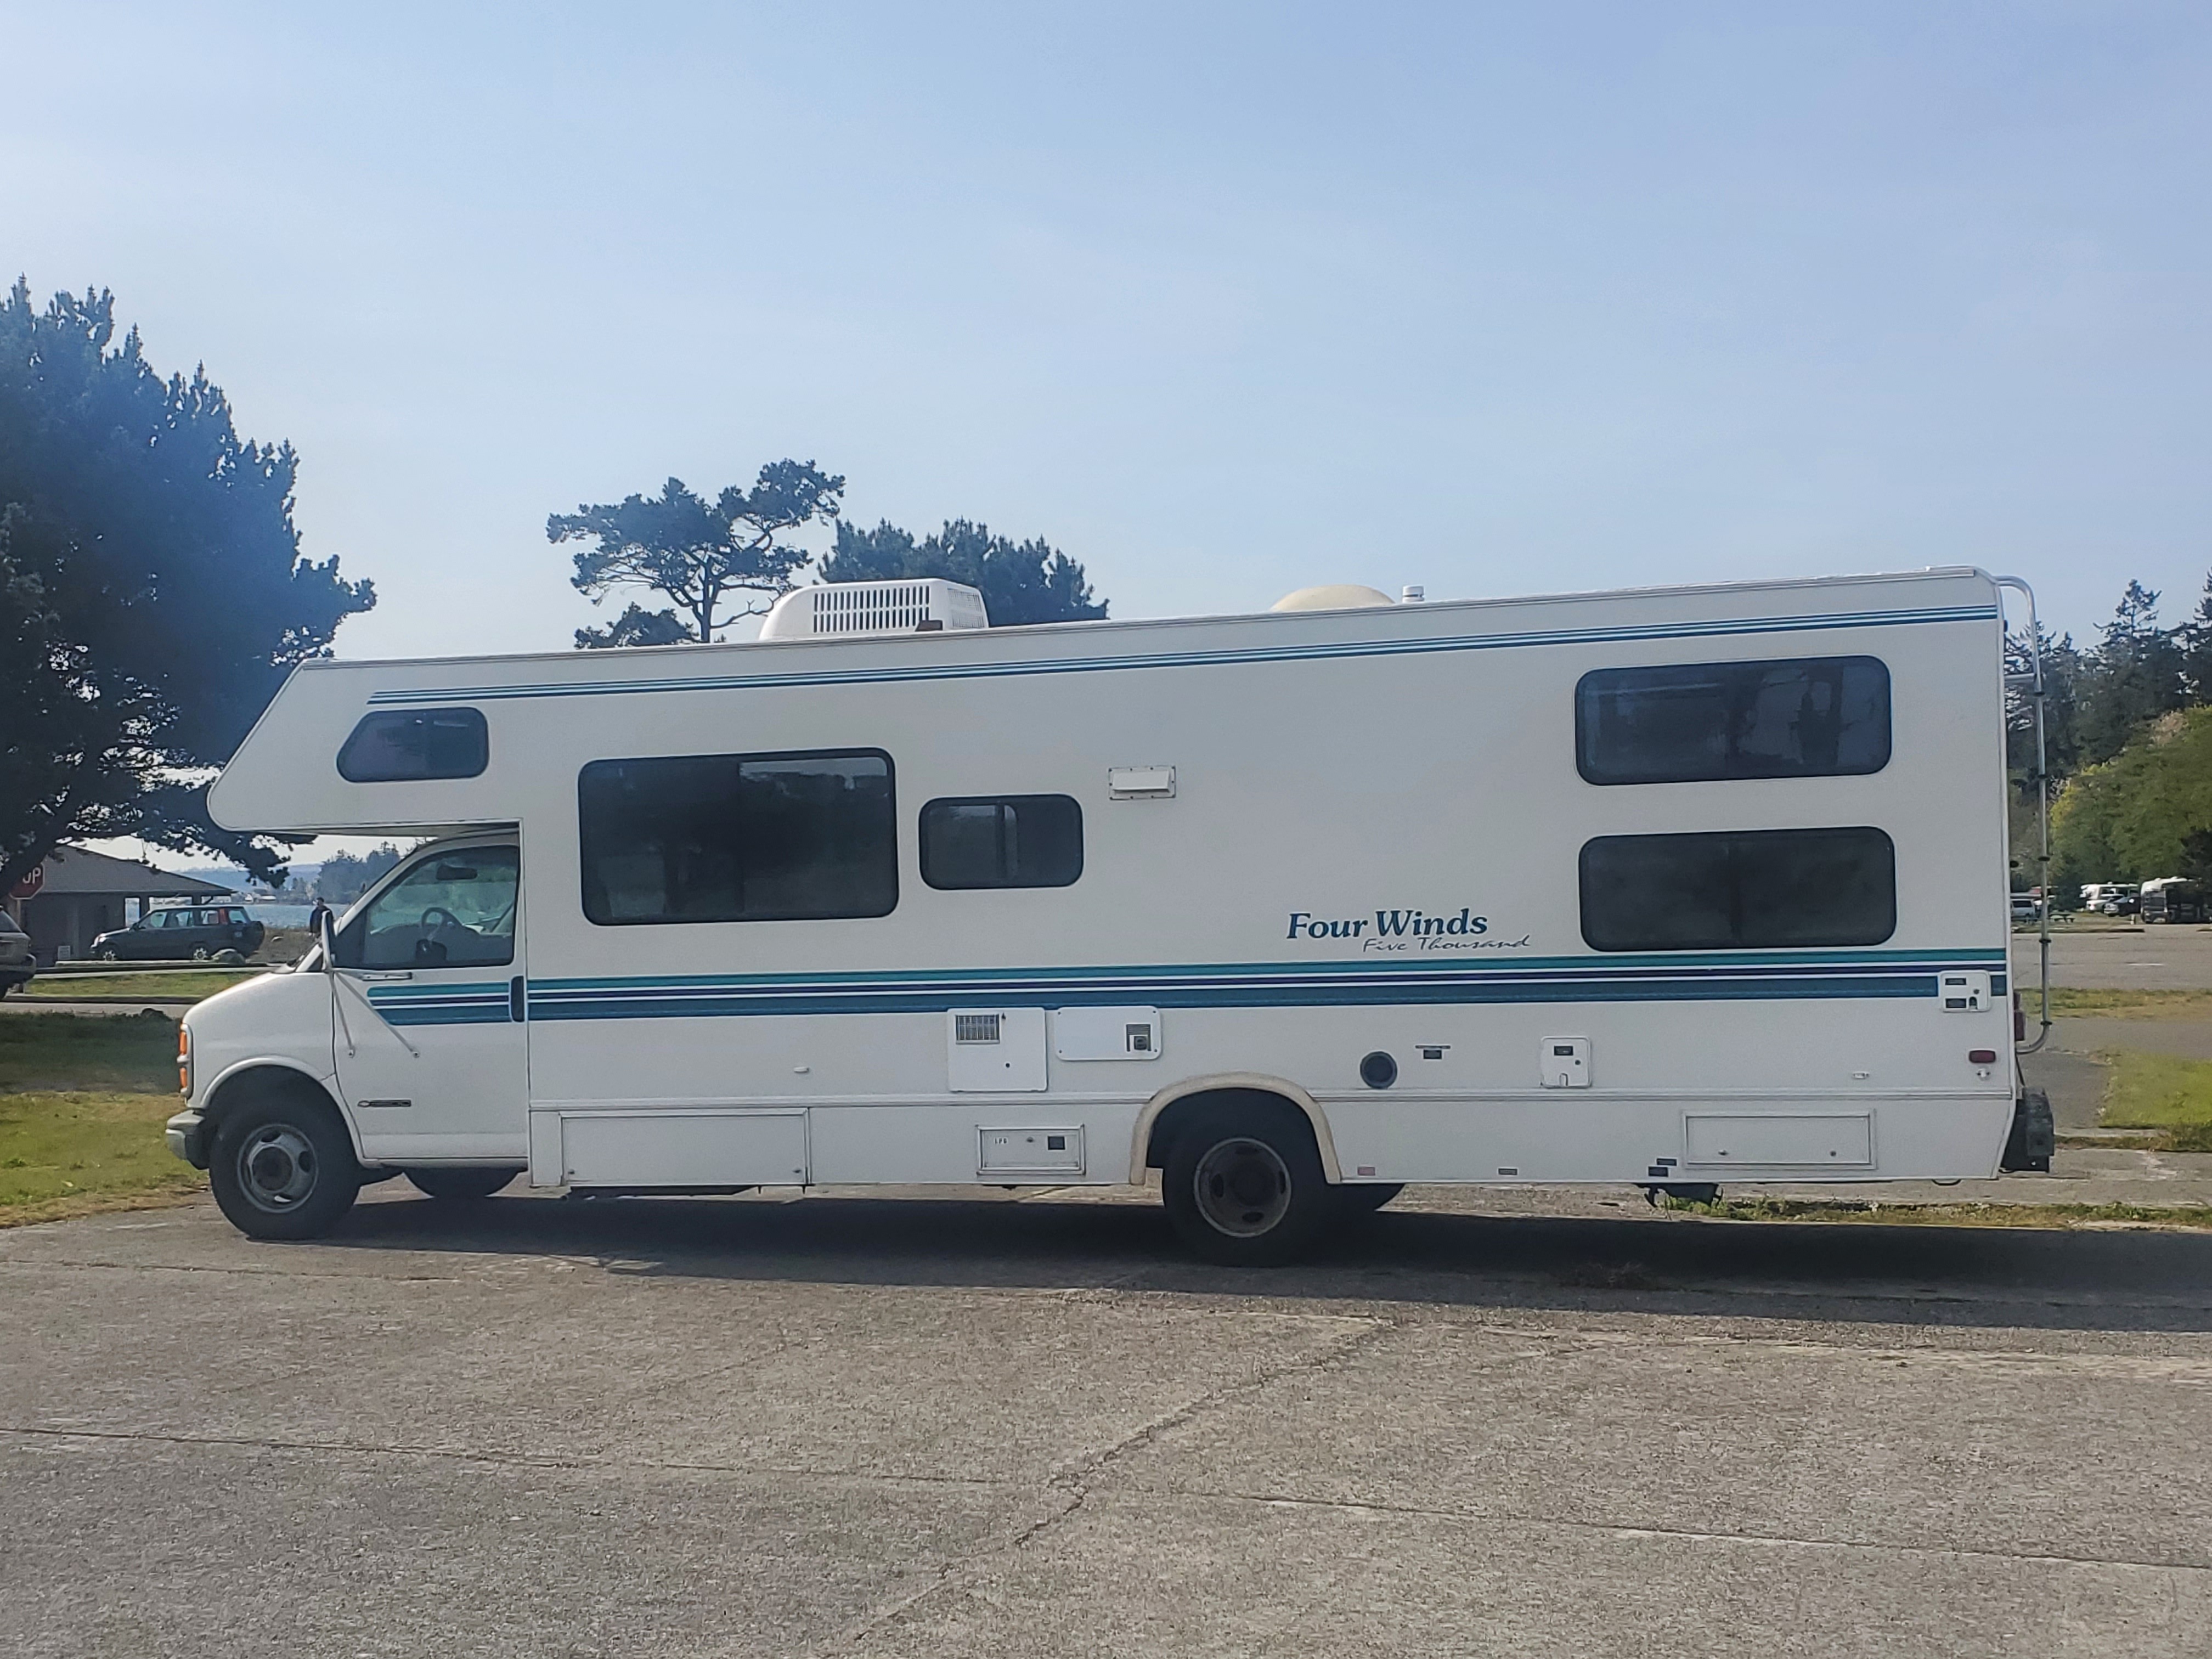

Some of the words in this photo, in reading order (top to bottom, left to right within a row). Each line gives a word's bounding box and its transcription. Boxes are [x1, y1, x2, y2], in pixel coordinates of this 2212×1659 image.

[22, 867, 41, 884] OP
[1286, 913, 1368, 939] Four
[1375, 908, 1488, 936] Winds
[1363, 938, 1408, 952] Five
[1418, 934, 1531, 950] Thousand
